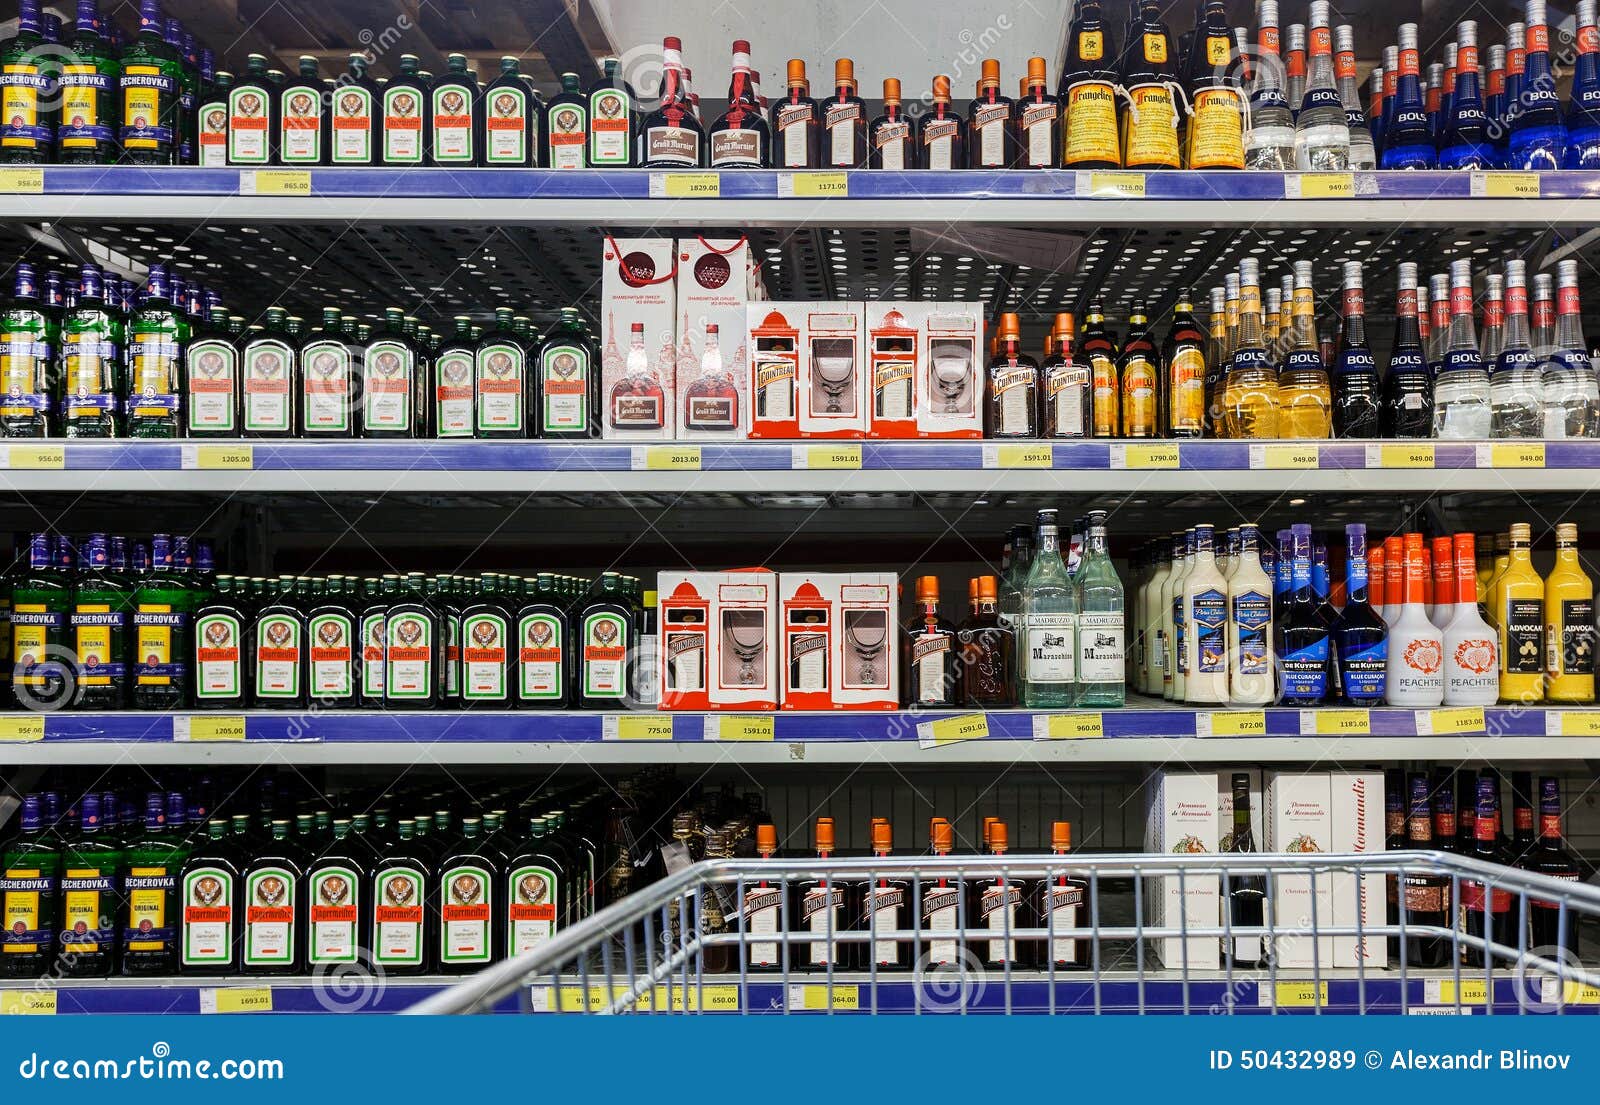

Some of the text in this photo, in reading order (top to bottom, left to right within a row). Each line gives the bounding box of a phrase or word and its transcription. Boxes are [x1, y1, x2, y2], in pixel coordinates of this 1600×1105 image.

[58, 75, 106, 87] BECHEROVKA
[120, 76, 169, 88] BECHEROVKA
[1312, 92, 1340, 102] BOLS
[1398, 112, 1427, 122] BOLS
[1459, 110, 1487, 120] BOLS
[1236, 352, 1266, 362] BOLS
[1290, 354, 1320, 364] BOLS
[1347, 356, 1374, 364] BOLS
[1390, 356, 1422, 366] BOLS
[1452, 354, 1482, 364] BOLS
[1506, 354, 1536, 364] BOLS
[760, 364, 794, 384] COINTREAU
[878, 364, 912, 385] COINTREAU
[997, 371, 1031, 391] COINTREAU
[1052, 371, 1086, 391] COINTREAU
[10, 614, 55, 624] BECHEROVKA
[71, 614, 119, 624] BECHEROVKA
[134, 614, 180, 624] BECHEROVKA
[1456, 718, 1483, 726] 1183.00
[959, 723, 986, 734] 1591.01
[0, 880, 48, 889] BECHEROVKA
[62, 879, 108, 889] BECHEROVKA
[126, 878, 174, 888] BECHEROVKA
[8, 906, 33, 914] ORIGINAL
[186, 908, 230, 921] Jägermeister
[313, 907, 356, 919] Jägermeister
[378, 908, 421, 921] Jägermeister
[444, 906, 488, 919] Jägermeister
[512, 906, 554, 919] Jägermeister
